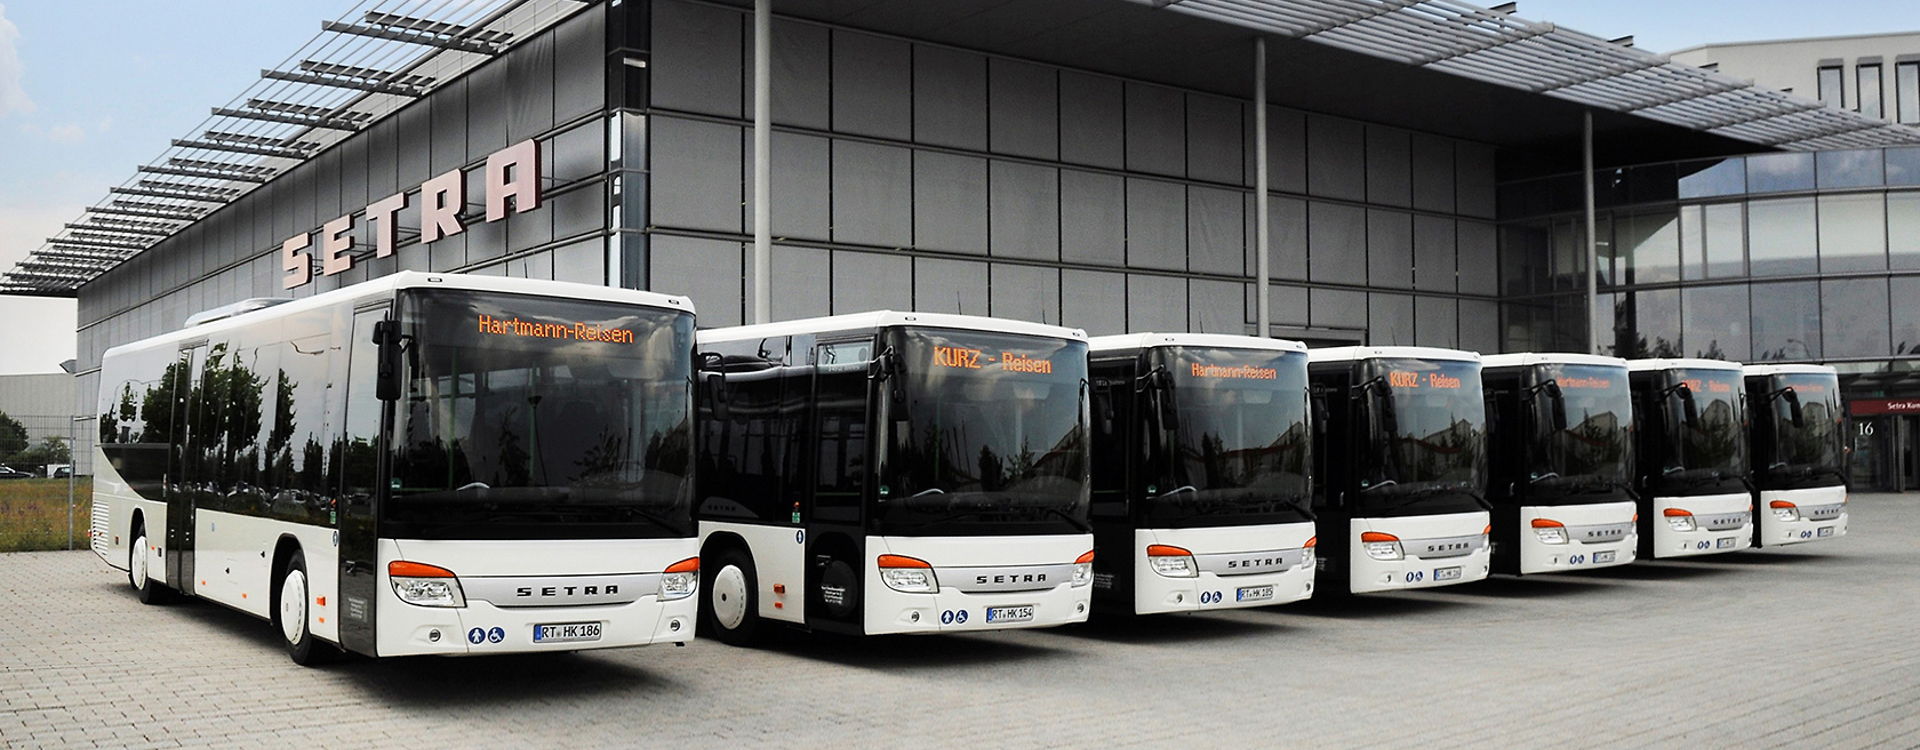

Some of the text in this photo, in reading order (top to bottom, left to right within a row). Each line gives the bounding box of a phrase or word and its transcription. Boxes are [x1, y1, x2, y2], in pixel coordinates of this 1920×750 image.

[282, 138, 542, 290] SETRA
[478, 314, 634, 343] Hartmann-Reisen
[934, 346, 981, 369] KURZ
[1002, 352, 1052, 373] Reisen
[1192, 362, 1277, 379] Hartmann-Reisen
[1390, 372, 1419, 388] KURZ
[1887, 402, 1905, 410] Setra
[1859, 421, 1874, 436] 16
[1427, 542, 1469, 552] SETRA
[1228, 557, 1282, 568] SETRA
[976, 573, 1046, 584] SETRA
[516, 585, 618, 597] SETRA
[992, 608, 1032, 620] RT HK 154
[541, 625, 600, 638] RT HK 186
